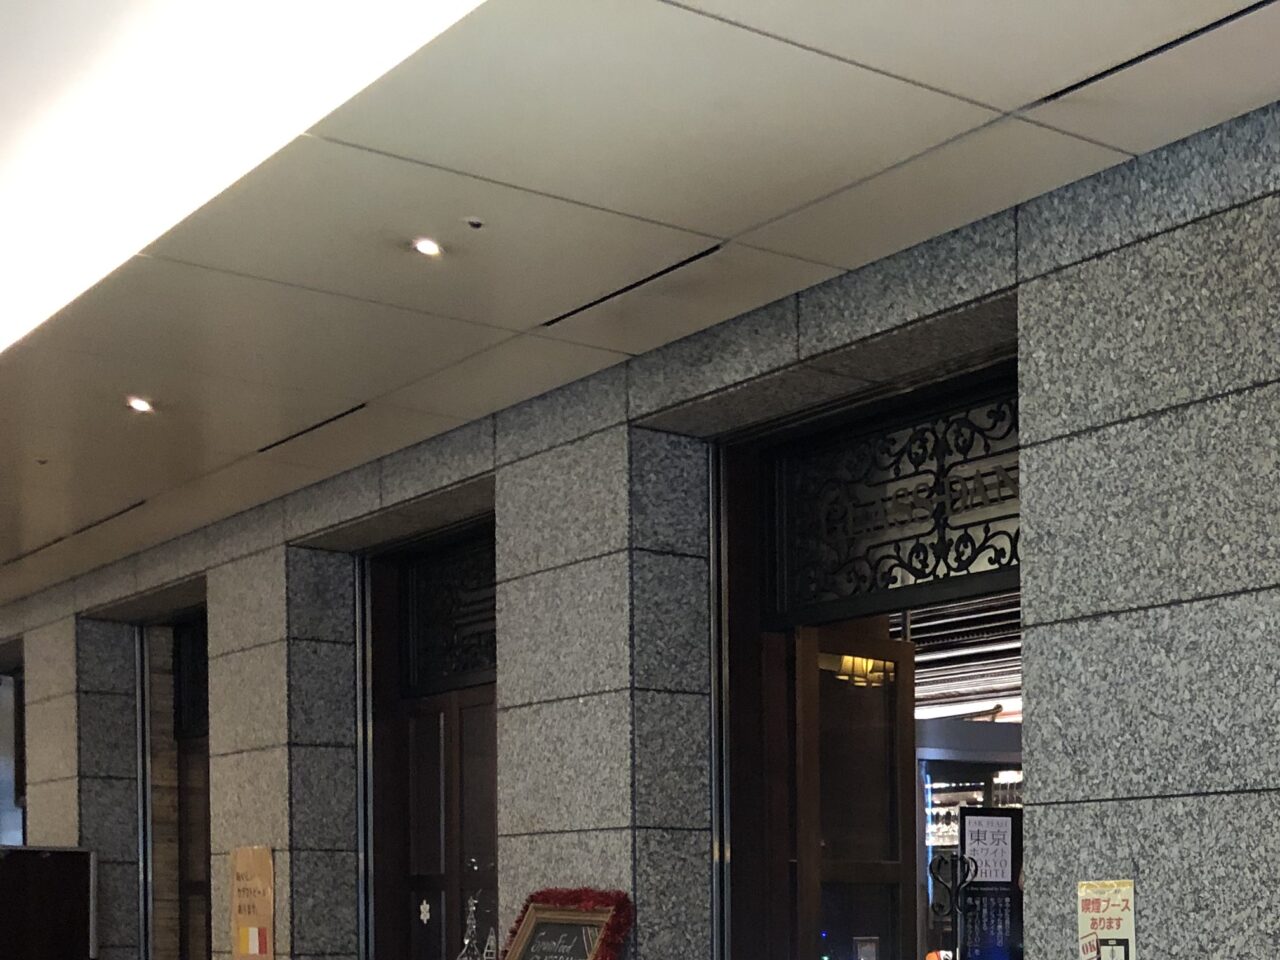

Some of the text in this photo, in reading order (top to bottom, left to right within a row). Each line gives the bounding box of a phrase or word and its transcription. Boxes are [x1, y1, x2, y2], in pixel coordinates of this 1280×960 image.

[968, 829, 1008, 846] 東京
[969, 847, 1007, 857] ホワイト
[1081, 898, 1131, 913] 喫煙ブース
[1090, 917, 1123, 930] あります
[1082, 940, 1096, 955] OK
